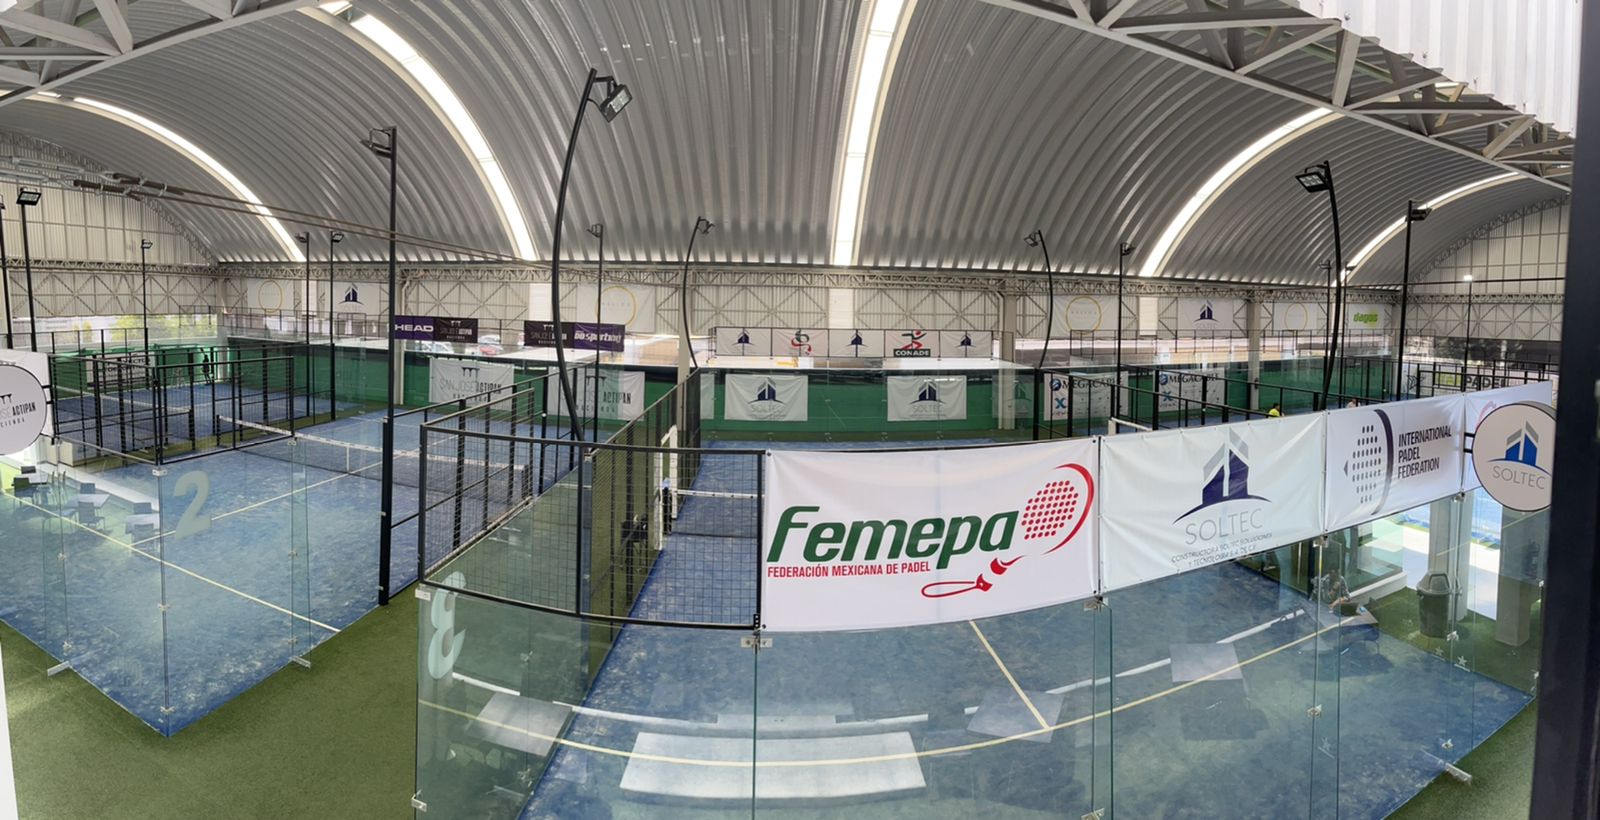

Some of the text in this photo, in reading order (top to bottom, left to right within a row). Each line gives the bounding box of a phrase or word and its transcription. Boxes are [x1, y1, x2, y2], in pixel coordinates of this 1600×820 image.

[394, 324, 434, 332] HEAD
[895, 349, 930, 357] CONADE
[1398, 425, 1452, 447] INTERNATIONAL
[1398, 447, 1421, 463] PADEL
[1397, 457, 1440, 479] FEDERATION
[1492, 465, 1547, 490] SOLTEC
[174, 470, 213, 539] 2
[1185, 508, 1263, 545] SOLTEC
[767, 561, 931, 578] FEDERACIÓN MEXICANA DE PADEL
